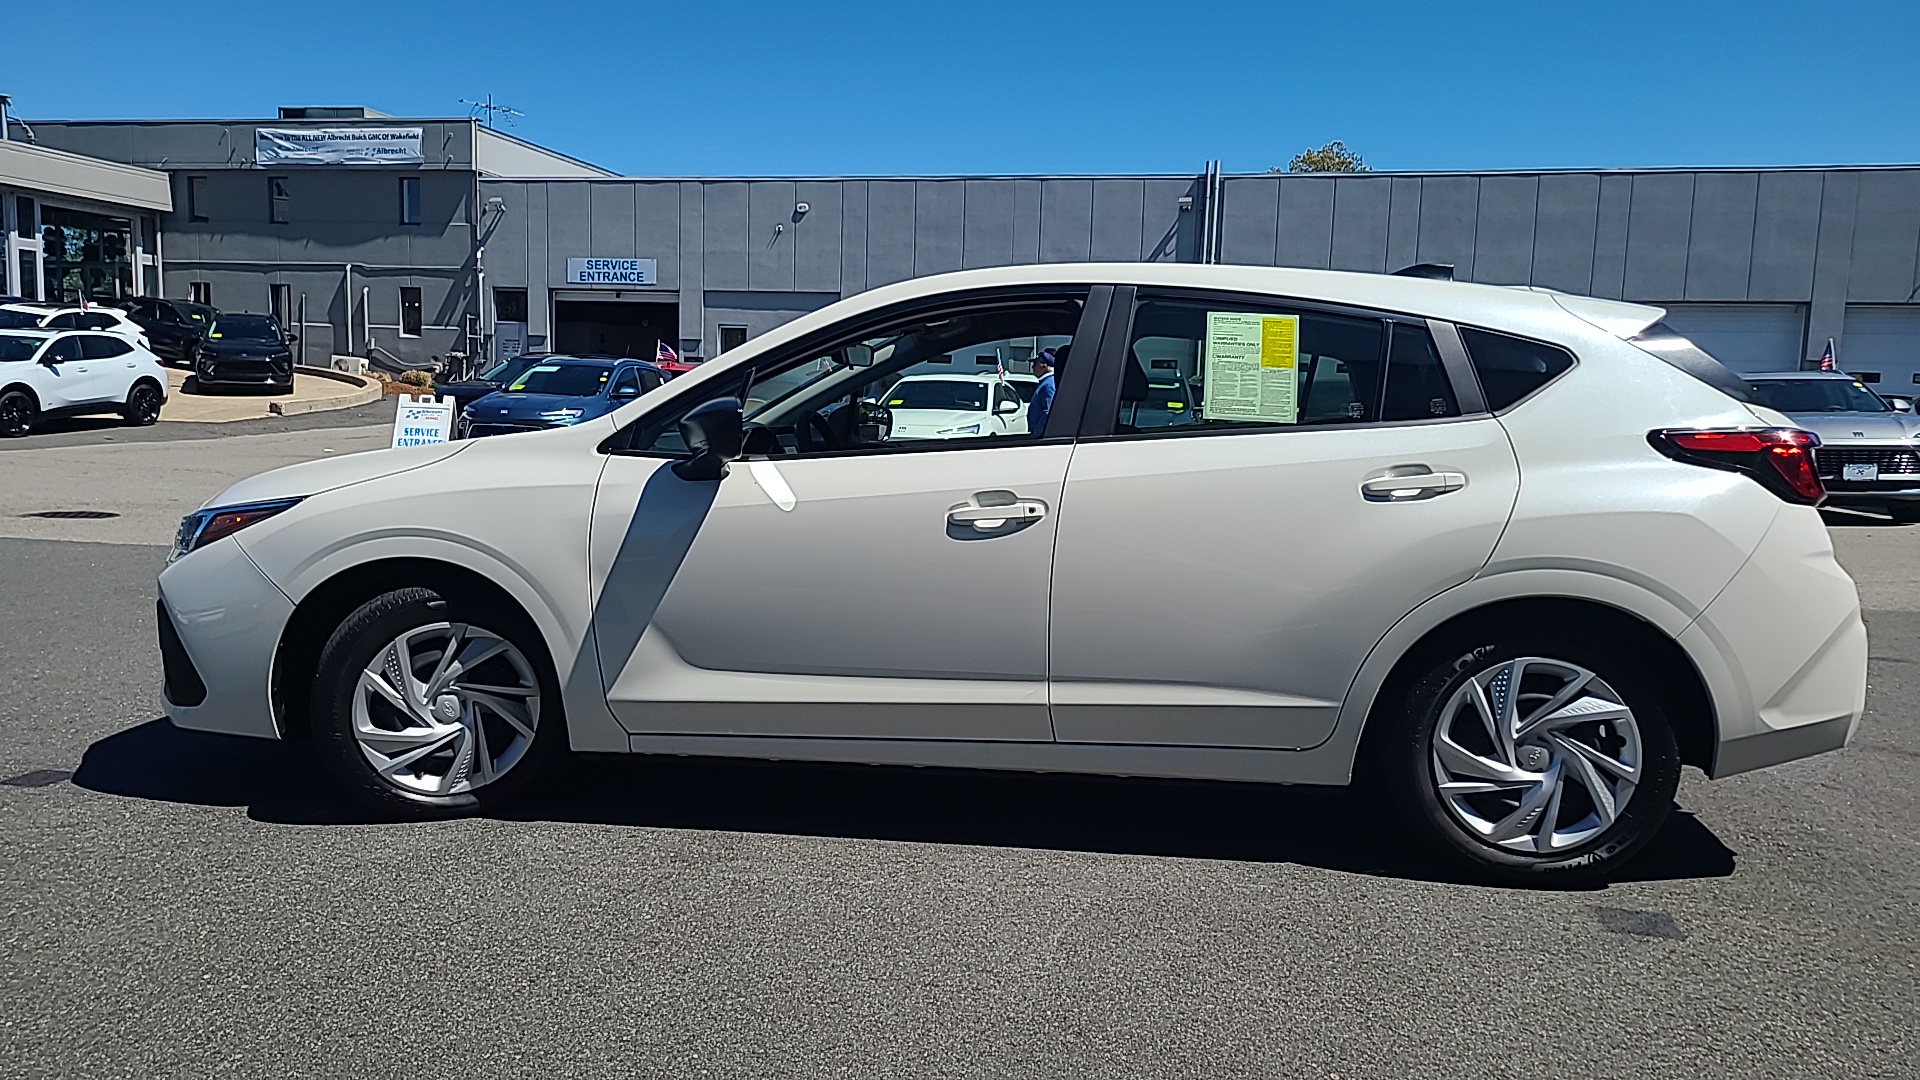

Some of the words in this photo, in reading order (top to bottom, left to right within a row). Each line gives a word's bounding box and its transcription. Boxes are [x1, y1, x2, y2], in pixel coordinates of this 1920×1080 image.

[390, 132, 419, 140] Wakefield
[376, 147, 407, 155] Albrecht
[586, 259, 638, 271] SERVICE
[579, 271, 645, 283] ENTRANCE
[404, 427, 440, 437] SERVICE
